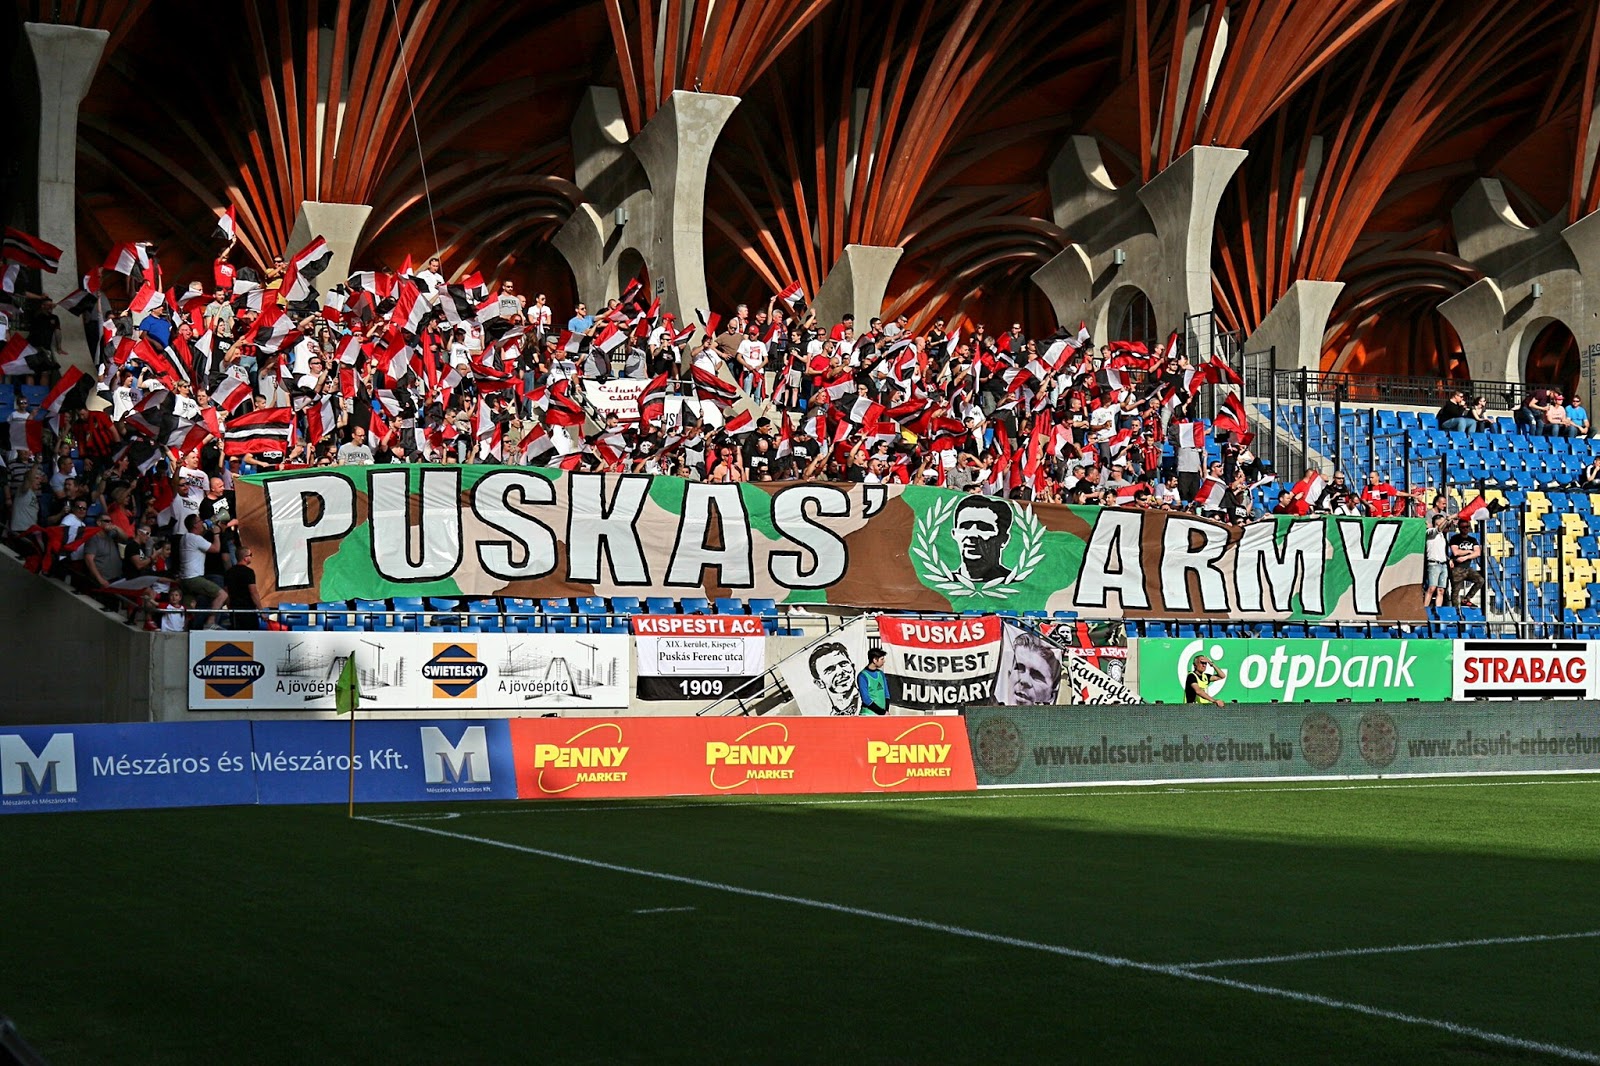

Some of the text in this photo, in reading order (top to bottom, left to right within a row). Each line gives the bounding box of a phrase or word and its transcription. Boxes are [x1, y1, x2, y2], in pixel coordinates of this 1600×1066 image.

[1074, 507, 1402, 615] ARMY
[637, 618, 761, 633] KISPESTI AC.
[901, 621, 985, 644] PUSKÁS
[665, 640, 736, 649] XIX. kerület, Kispest
[659, 651, 743, 661] Puskás Ferenc utca
[903, 651, 989, 673] KISPEST
[195, 664, 261, 677] SWIETELSKY
[424, 665, 485, 677] SWIETELSKY
[1239, 640, 1418, 701] otpbank
[1463, 656, 1587, 684] STRABAG
[276, 680, 285, 692] A
[498, 679, 568, 694] A jövőépítő
[679, 680, 723, 695] 1909
[902, 679, 994, 704] HUNGARY
[534, 744, 630, 768] PENNY
[706, 742, 796, 765] PENNY
[867, 741, 952, 764] PENNY
[1033, 733, 1293, 766] www.alcsuti-arboretum.hu
[92, 748, 408, 776] Mészáros és Mészáros Kft.
[576, 772, 628, 782] MARKET
[746, 769, 795, 779] MARKET
[906, 768, 951, 777] MARKET
